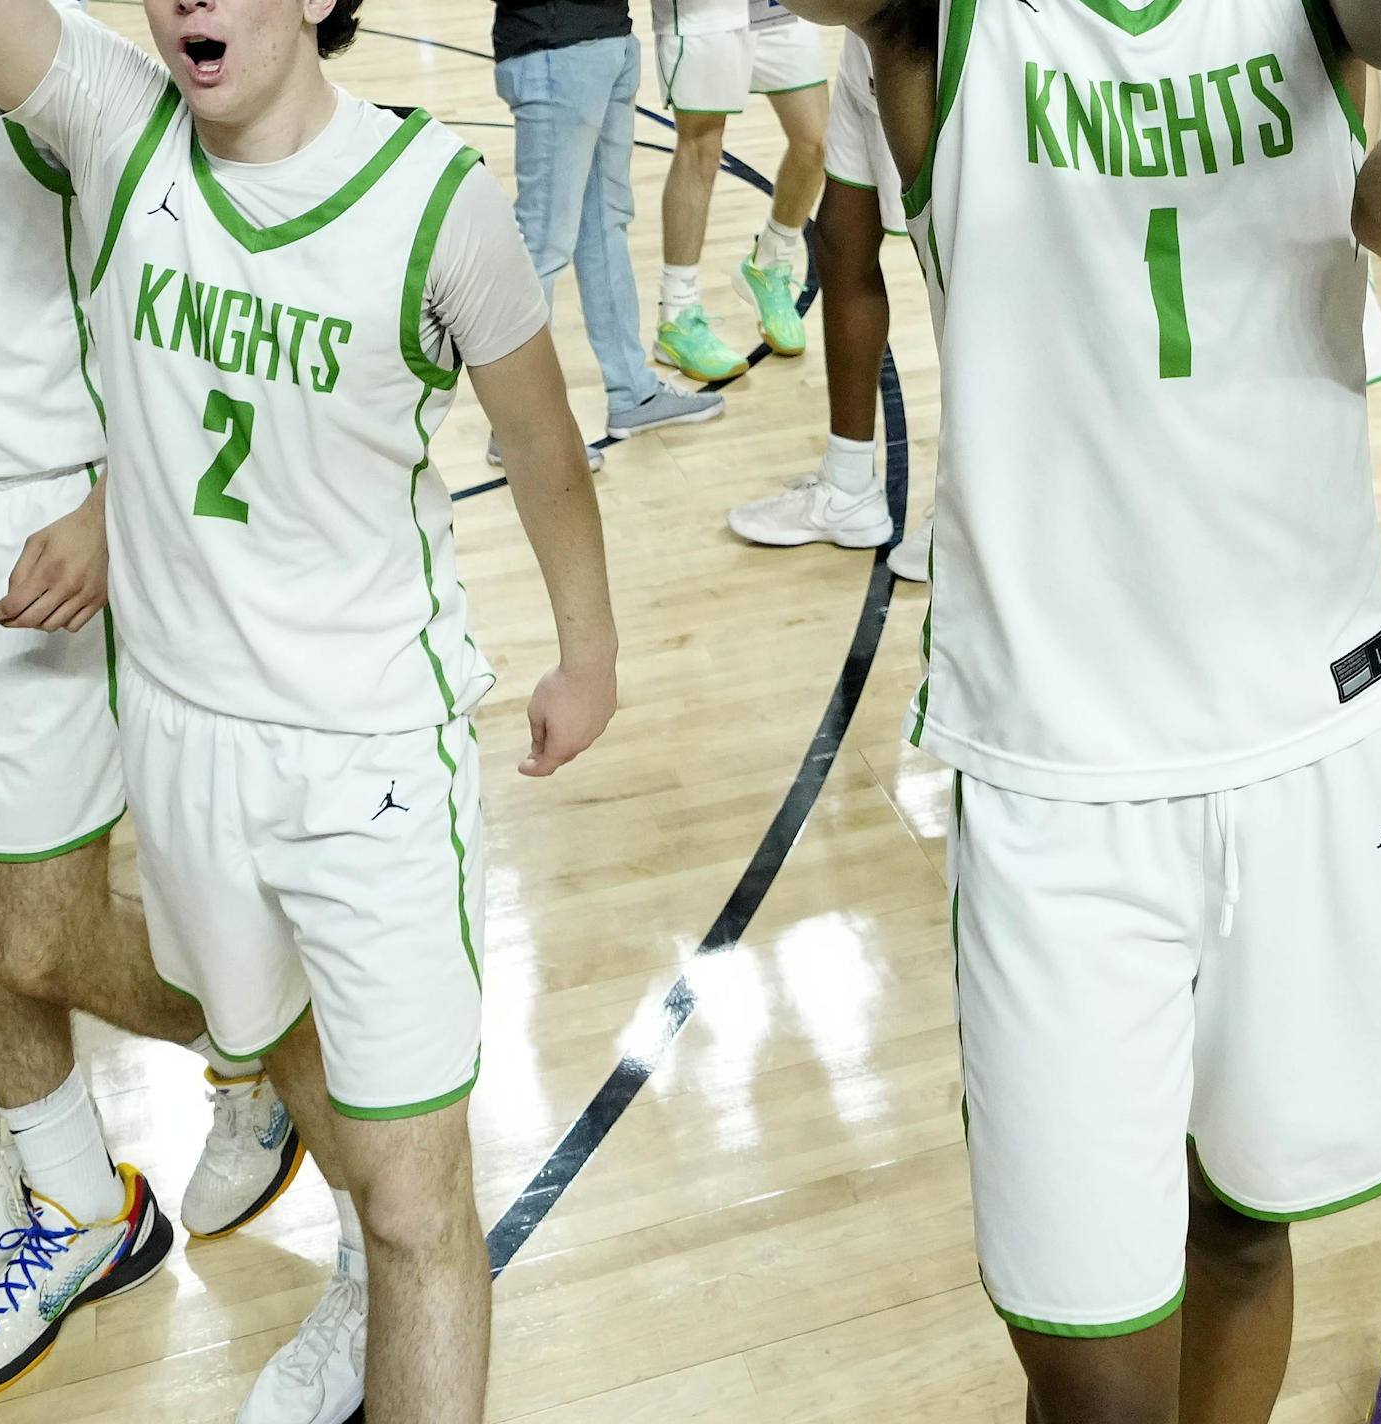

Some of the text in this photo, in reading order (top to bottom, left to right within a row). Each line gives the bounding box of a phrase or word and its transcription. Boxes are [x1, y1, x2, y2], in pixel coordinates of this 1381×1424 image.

[1025, 53, 1295, 178] KNIGHTS
[134, 263, 352, 394] KNIGHTS
[1144, 207, 1192, 379] 1
[193, 389, 258, 524] 2
